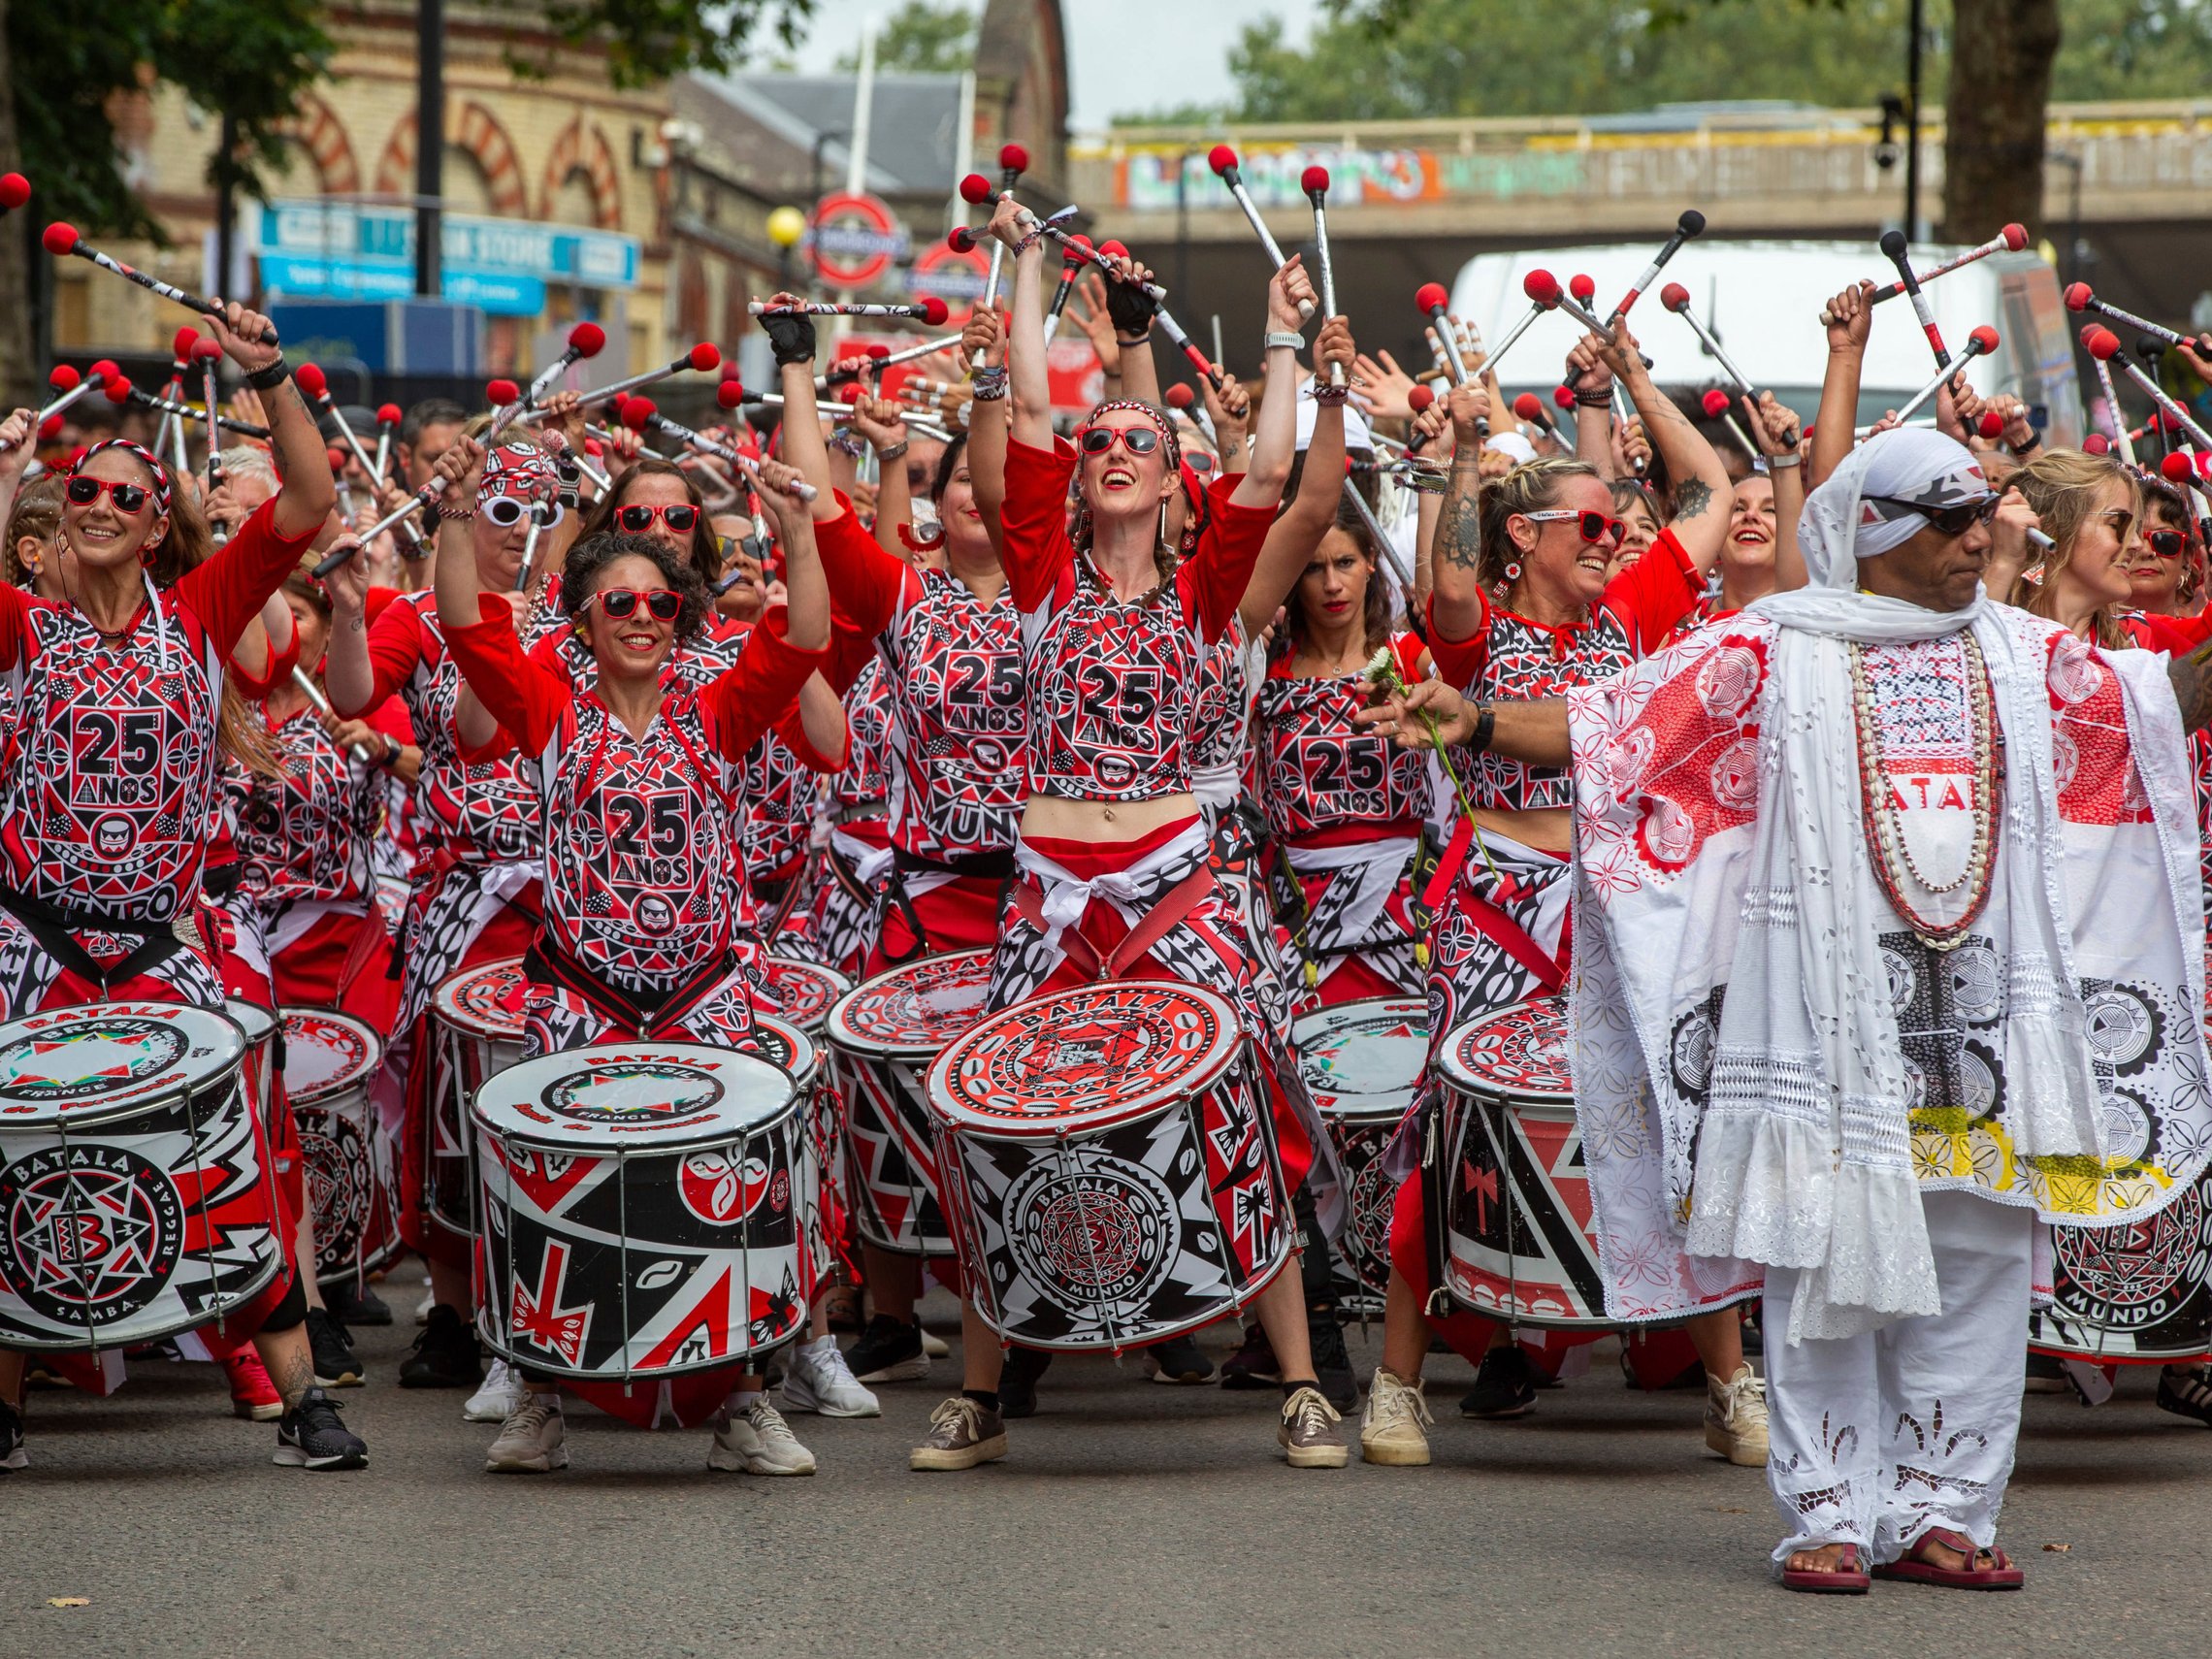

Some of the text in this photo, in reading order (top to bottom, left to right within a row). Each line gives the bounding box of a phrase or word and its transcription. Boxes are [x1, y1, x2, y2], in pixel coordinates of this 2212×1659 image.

[949, 654, 1025, 706] 25
[1080, 663, 1158, 726] 25
[947, 705, 1025, 733] ANOS
[1078, 714, 1156, 751] ANOS
[75, 711, 162, 776] 25
[1305, 738, 1384, 791] 25
[72, 775, 158, 806] ANOS
[1315, 790, 1386, 817] ANOS
[1524, 779, 1572, 808] AN
[606, 793, 689, 858] 25
[922, 789, 1019, 846] MUN
[612, 854, 690, 887] ANOS
[890, 960, 992, 990] BATA
[21, 1005, 182, 1029] BATALA
[1019, 994, 1174, 1028] BATALA
[40, 1019, 152, 1040] BRASIL
[584, 1054, 723, 1071] BATALA
[600, 1065, 696, 1079] BRASIL
[18, 1083, 110, 1098] FRANCE
[577, 1111, 652, 1121] FRANCE
[13, 1149, 129, 1183] BATALA
[1036, 1178, 1119, 1207] BATALA
[152, 1181, 178, 1256] REGGAE
[1069, 1275, 1135, 1297] MUNDO
[56, 1300, 134, 1320] SAMBA
[2065, 1291, 2167, 1325] MUNDO
